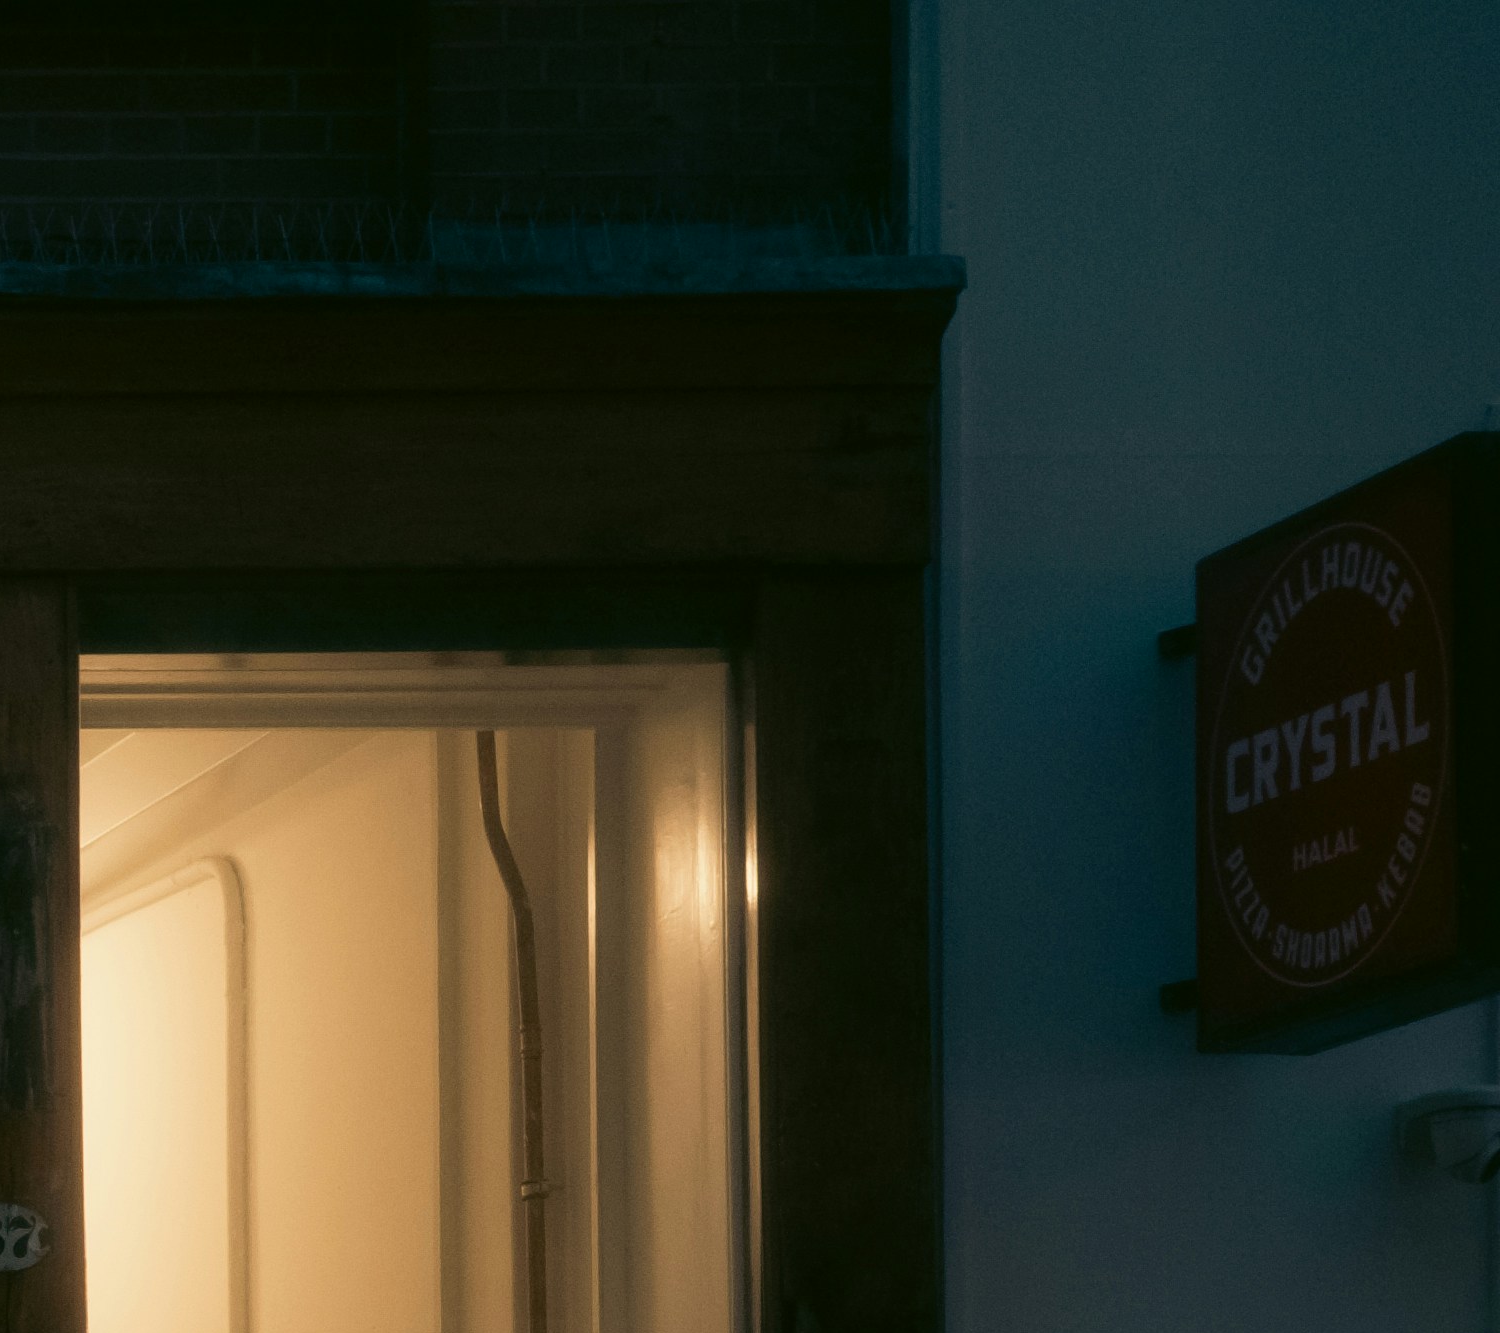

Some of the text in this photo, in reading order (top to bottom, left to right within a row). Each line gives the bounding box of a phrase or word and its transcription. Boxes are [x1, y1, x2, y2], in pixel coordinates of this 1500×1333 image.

[1239, 541, 1416, 687] GRILLHOUSE
[1224, 668, 1432, 816] CRYSTAL
[1224, 844, 1267, 942] PIZZA
[1376, 780, 1433, 910] KEBAB
[1292, 825, 1361, 873] HALAL
